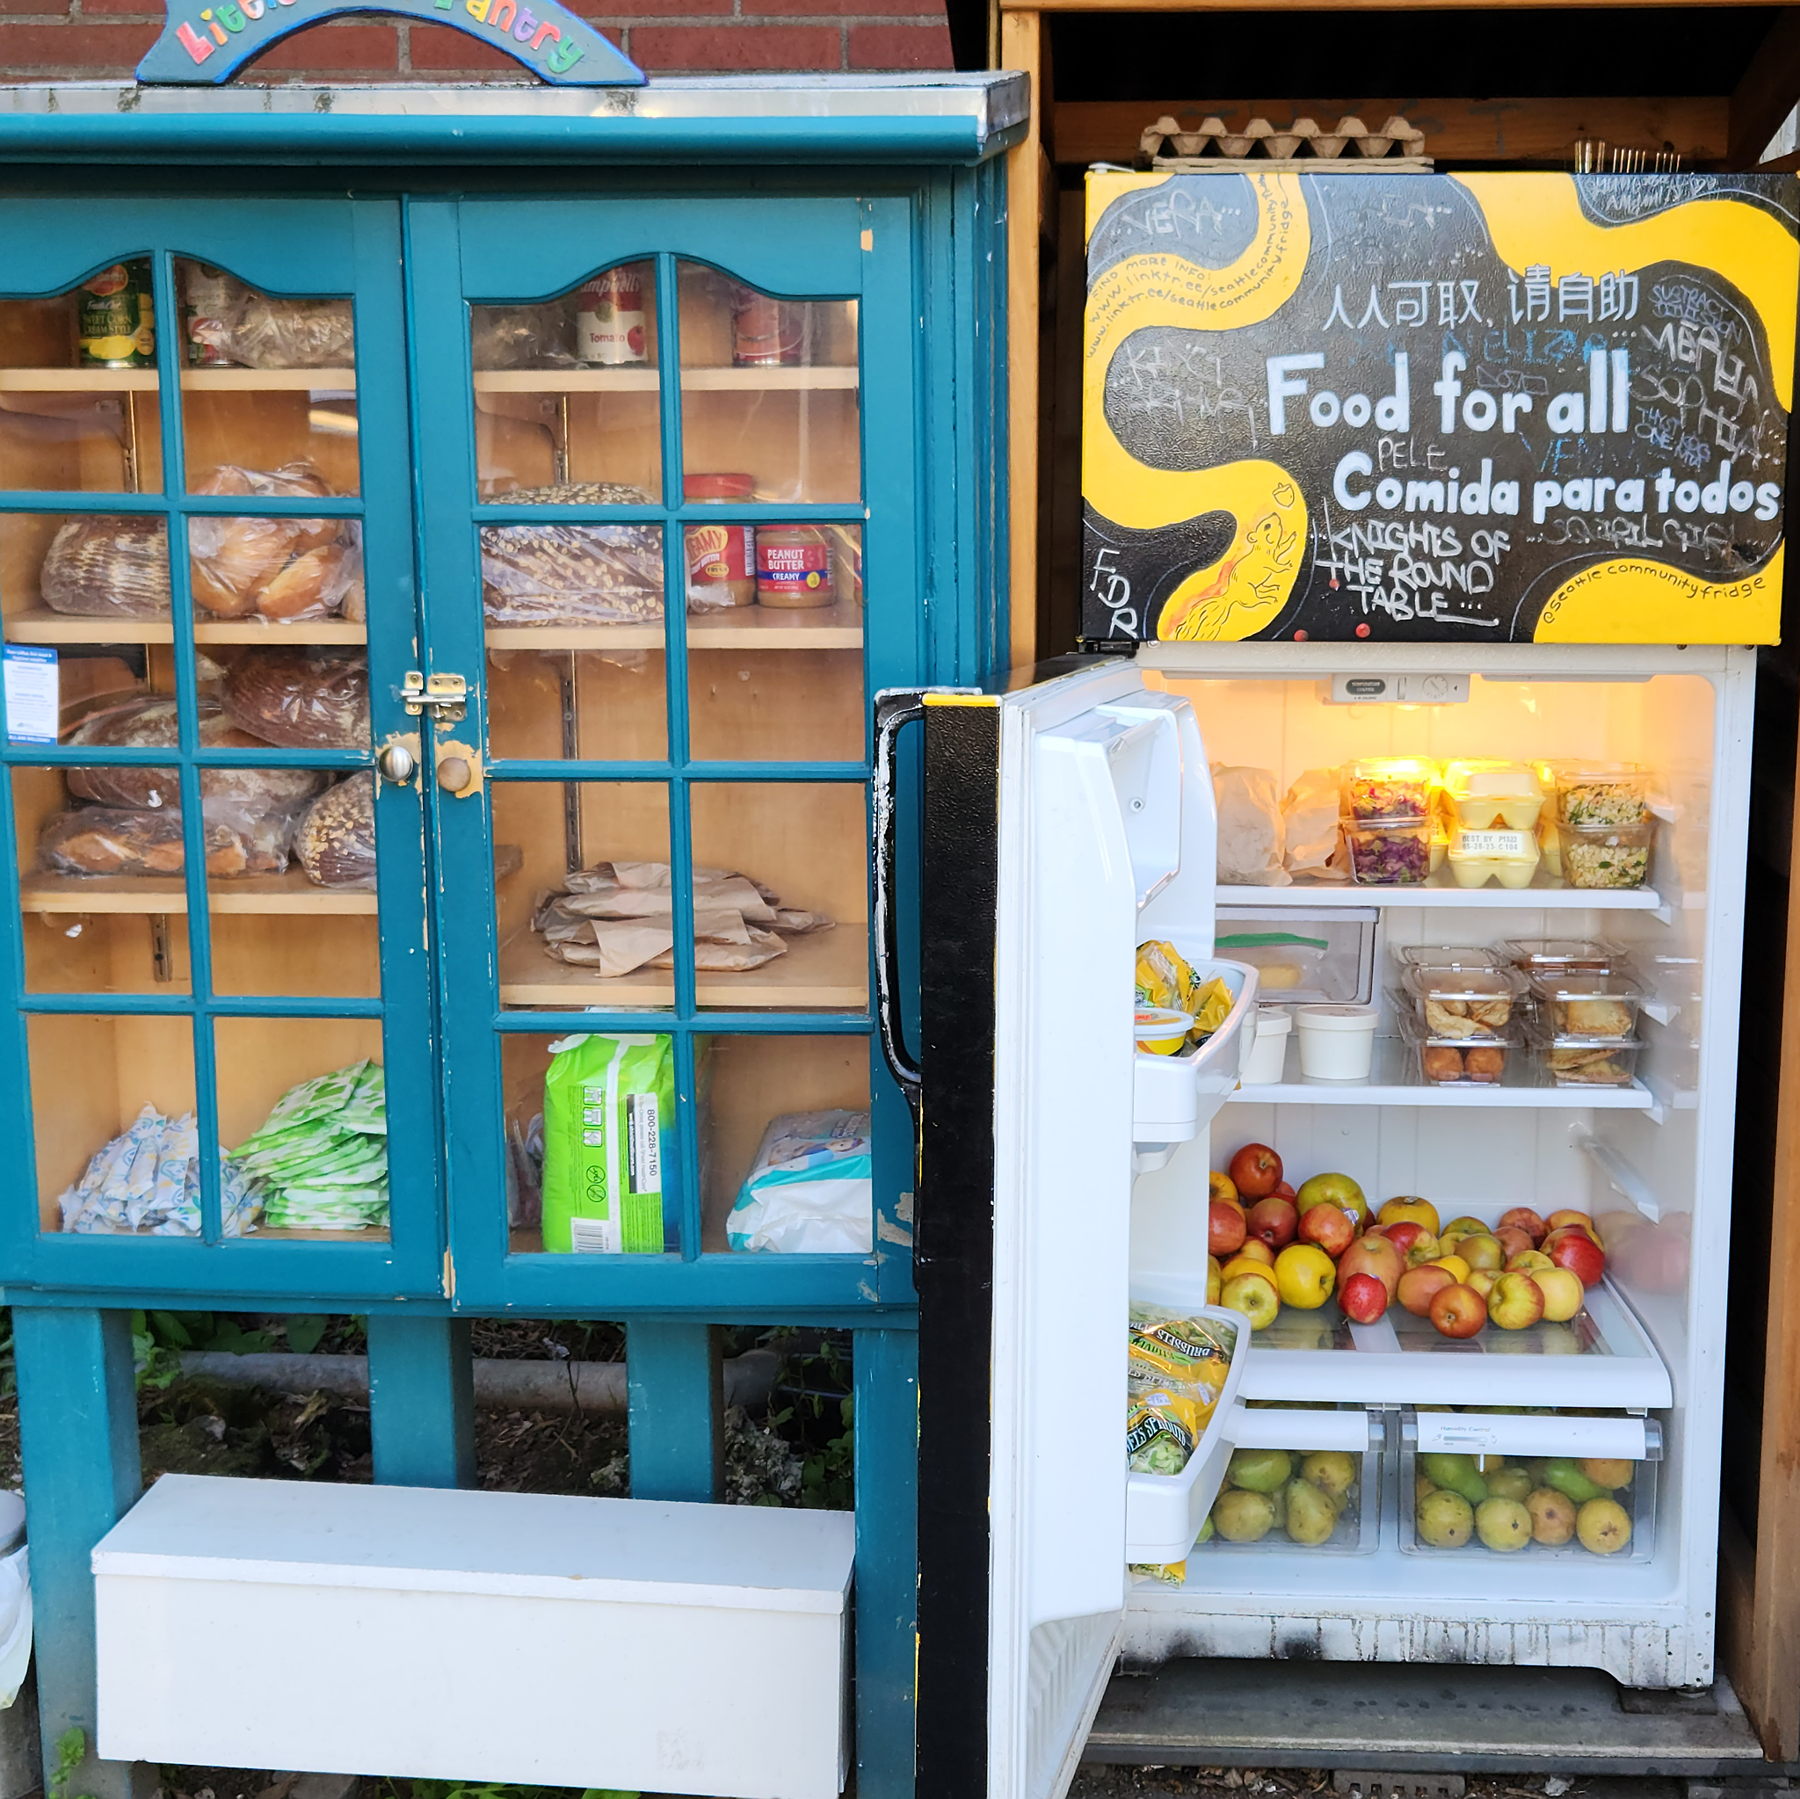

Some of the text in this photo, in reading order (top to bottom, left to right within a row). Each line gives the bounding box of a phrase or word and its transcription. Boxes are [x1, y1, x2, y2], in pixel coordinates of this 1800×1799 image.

[176, 0, 585, 74] Litt antry
[1126, 256, 1168, 271] MORE
[1266, 351, 1409, 435] Food
[1434, 351, 1534, 434] for
[1546, 350, 1630, 434] all
[1333, 450, 1520, 515] Comida
[1533, 478, 1645, 525] para
[1654, 459, 1781, 521] todos
[767, 549, 804, 559] PEANUT
[1322, 505, 1512, 564] KNIGHTS OF
[768, 560, 804, 570] BUTTER
[772, 572, 800, 581] CREAMY
[1315, 553, 1495, 595] THE ROUND
[647, 1108, 659, 1177] 800-228-7150
